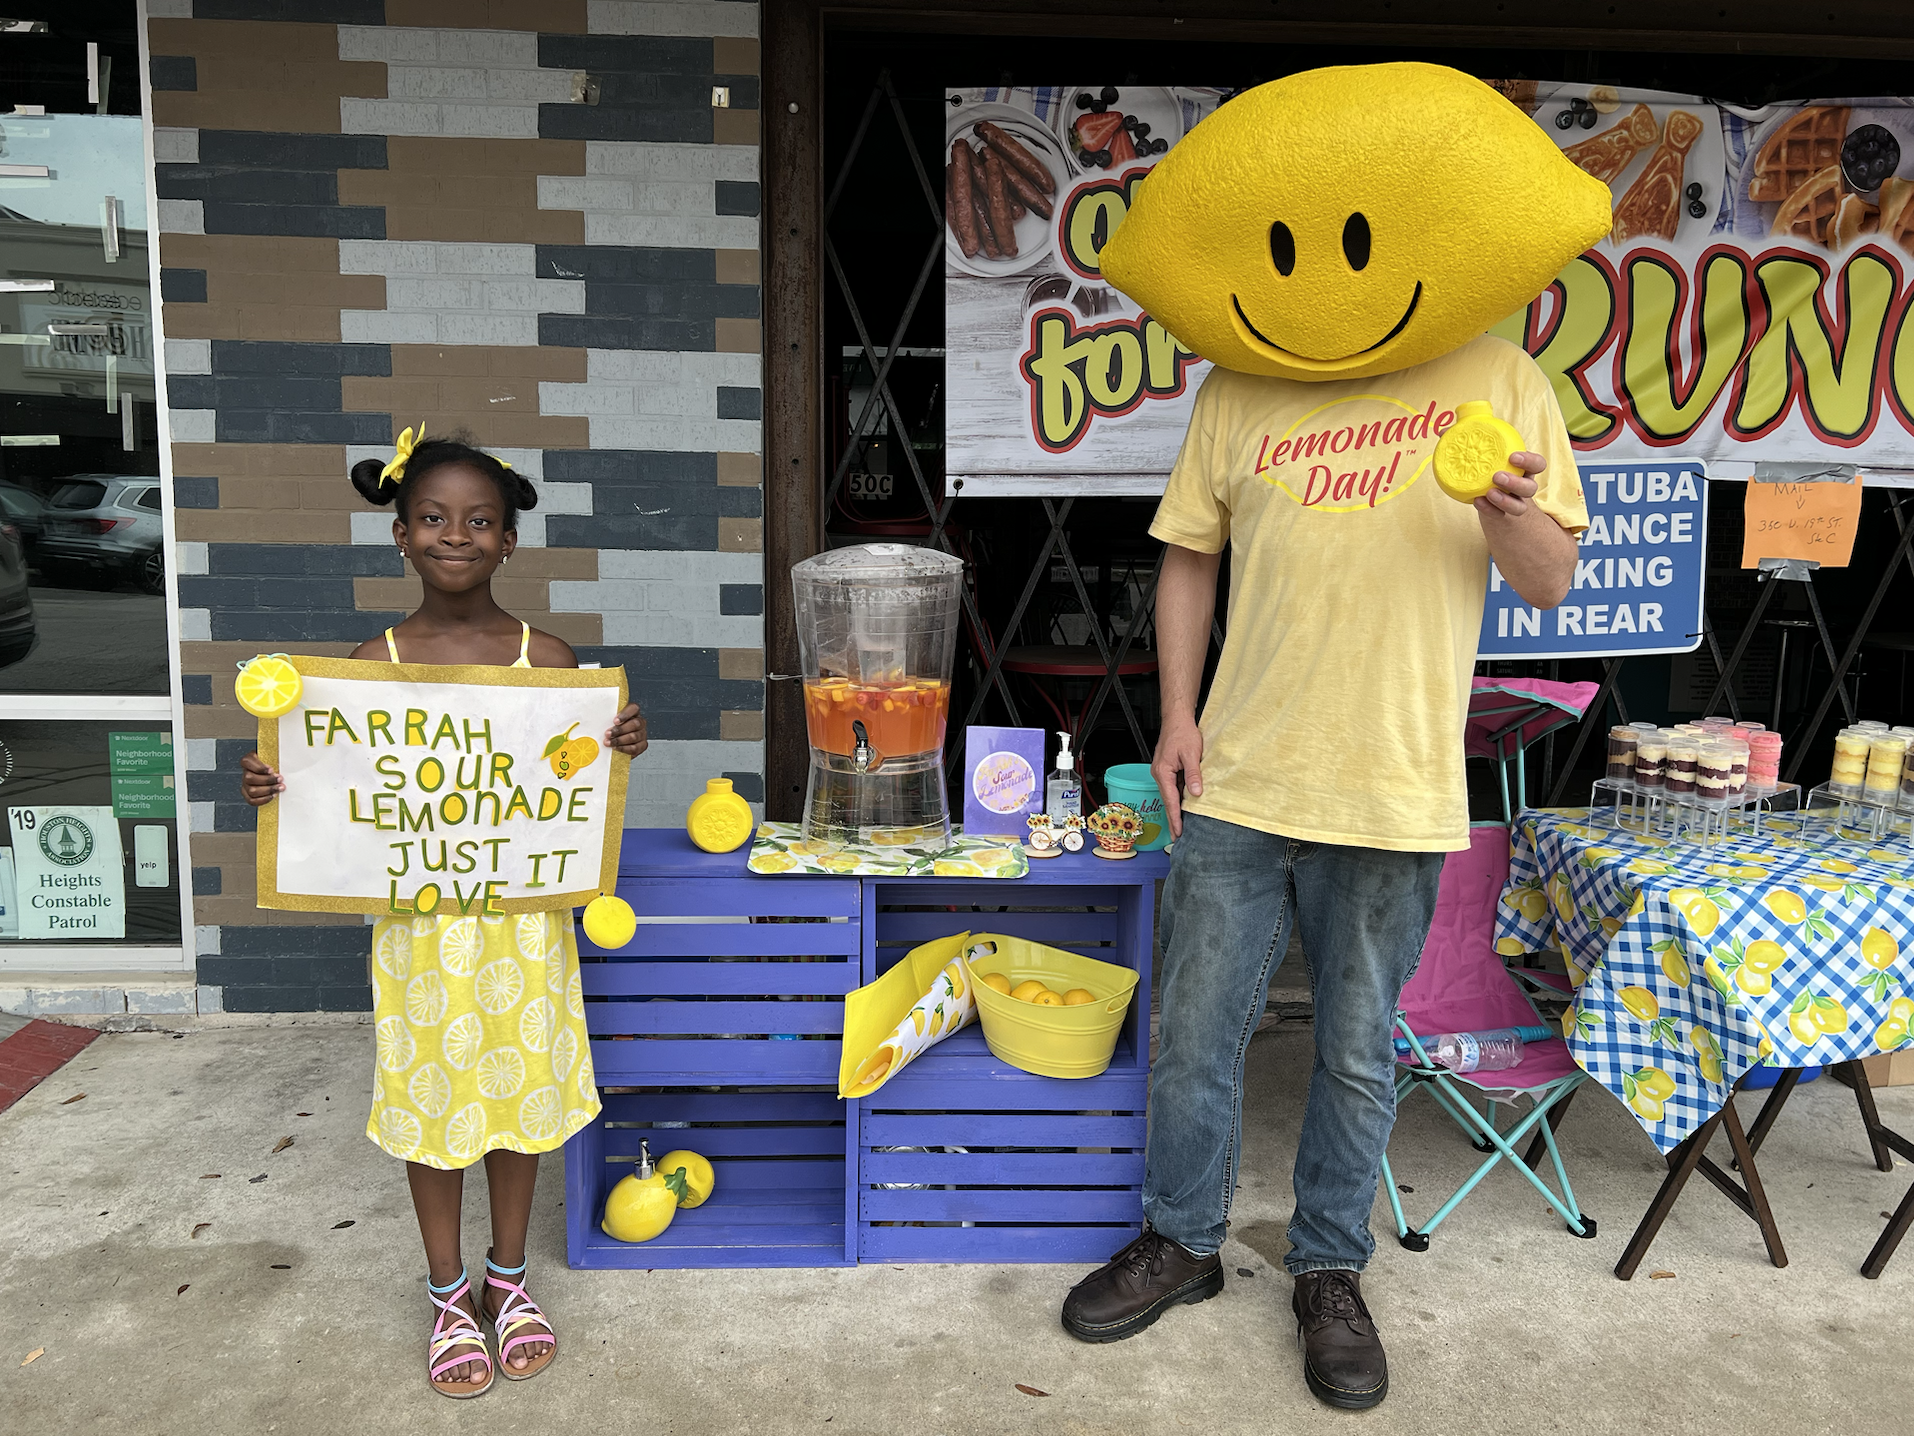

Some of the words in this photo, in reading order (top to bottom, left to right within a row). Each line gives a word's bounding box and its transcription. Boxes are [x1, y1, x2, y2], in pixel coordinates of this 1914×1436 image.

[1254, 400, 1454, 475] Lemonade
[1301, 451, 1402, 507] Day!
[1590, 471, 1699, 504] TUBA
[1774, 483, 1813, 495] MAIL
[1576, 512, 1693, 547] ANCE
[1497, 606, 1542, 638] IN
[1557, 602, 1665, 636] REAR
[304, 707, 493, 754] FARRAH
[116, 750, 172, 758] Neighborhood
[116, 758, 148, 766] Favorite
[375, 752, 514, 793] SOUR
[978, 767, 1033, 800] Lemonade
[118, 793, 174, 802] Neighborhood
[1138, 798, 1164, 814] hello
[40, 817, 65, 844] HOUSTON
[65, 817, 92, 843] HEIGHTS
[46, 848, 91, 865] ASSOCIATION
[140, 861, 157, 870] yelp
[387, 838, 511, 877] JUST
[525, 849, 578, 888] IT
[39, 873, 102, 890] Heights
[31, 894, 112, 909] Constable
[388, 879, 509, 917] LOVE
[48, 915, 97, 930] Patrol
